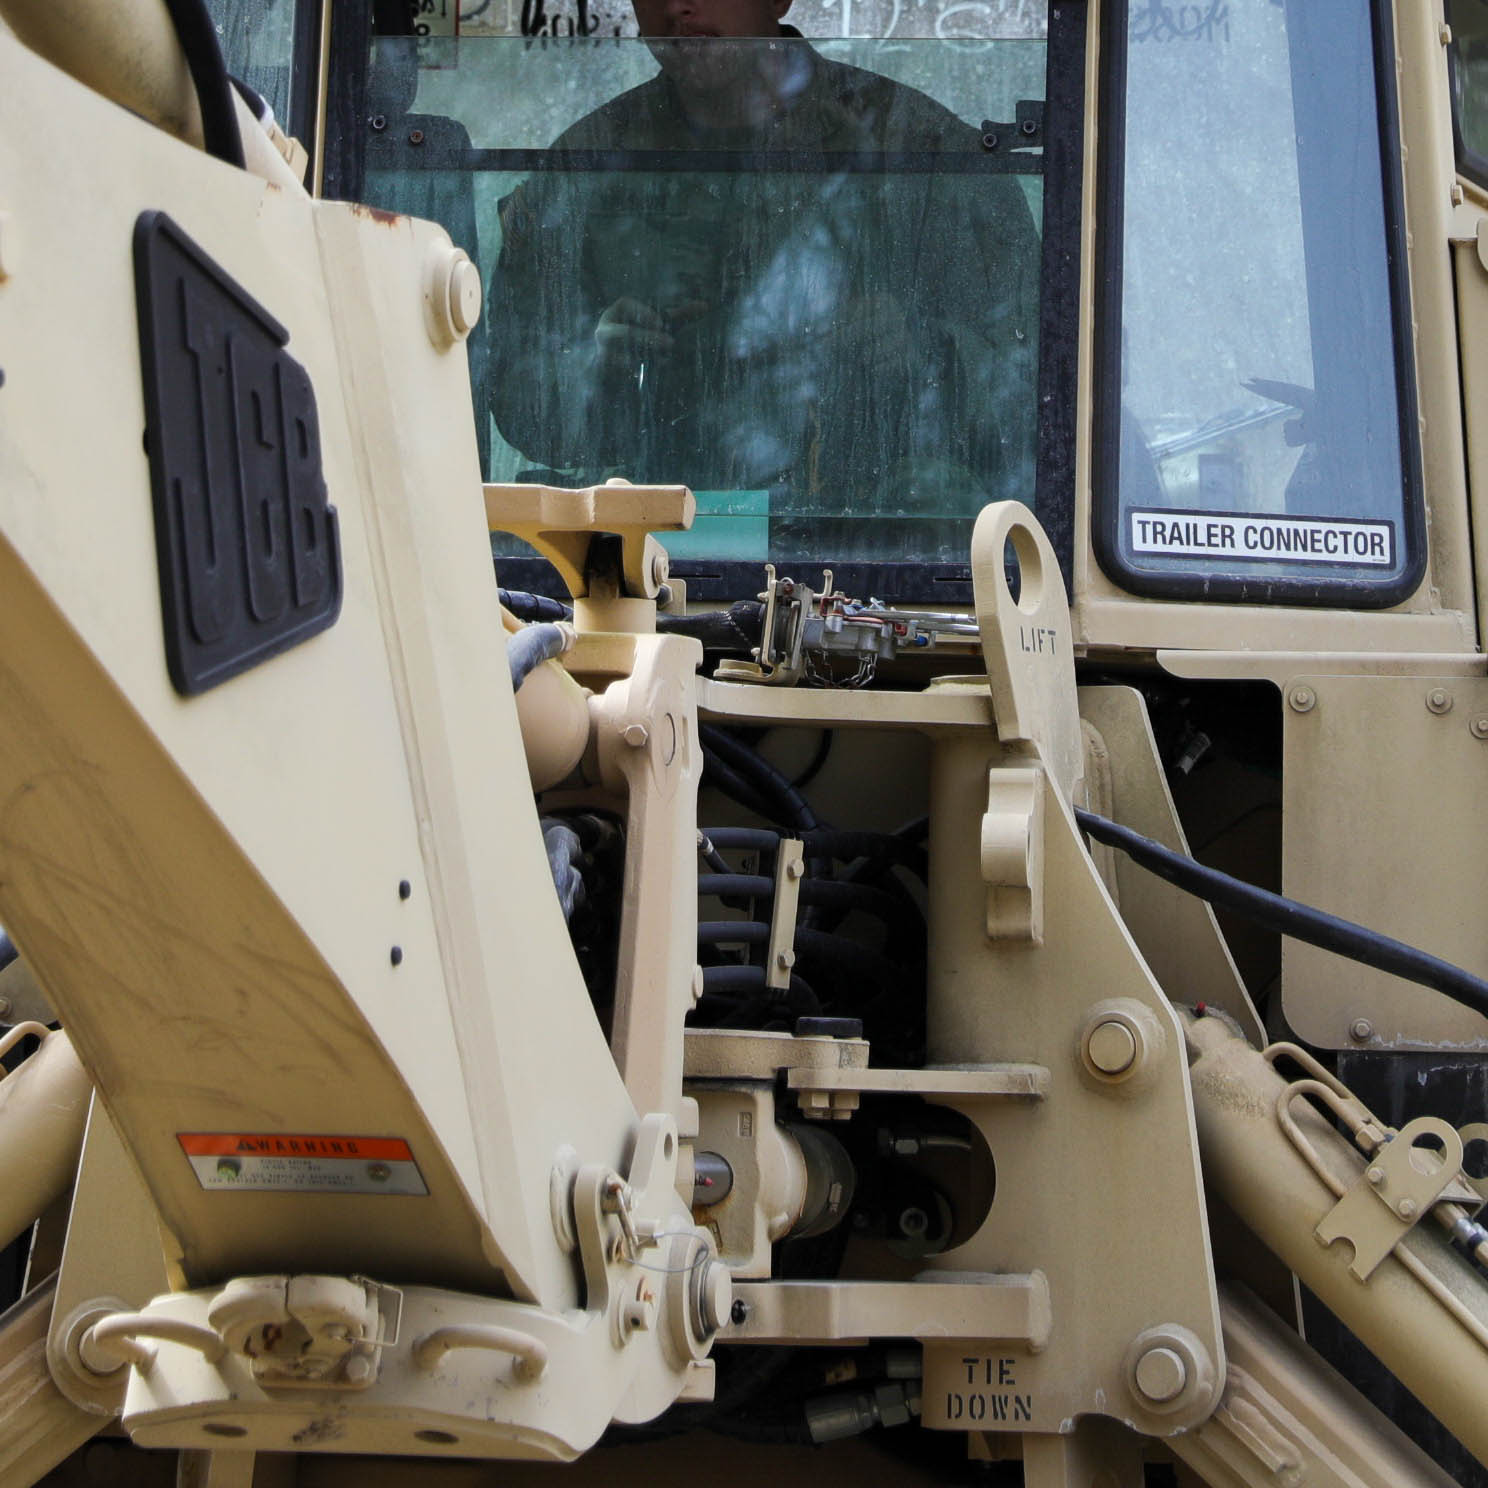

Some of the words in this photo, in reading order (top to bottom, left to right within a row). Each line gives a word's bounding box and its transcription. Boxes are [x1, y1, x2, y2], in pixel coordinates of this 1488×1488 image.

[172, 274, 327, 645] JCB
[1137, 519, 1235, 549] TRAILER
[1244, 525, 1385, 557] CONNECTOR
[1020, 625, 1056, 655] LIFT
[258, 1140, 360, 1154] WARNING
[963, 1358, 1015, 1385] TIE
[947, 1393, 1032, 1421] DOWN
